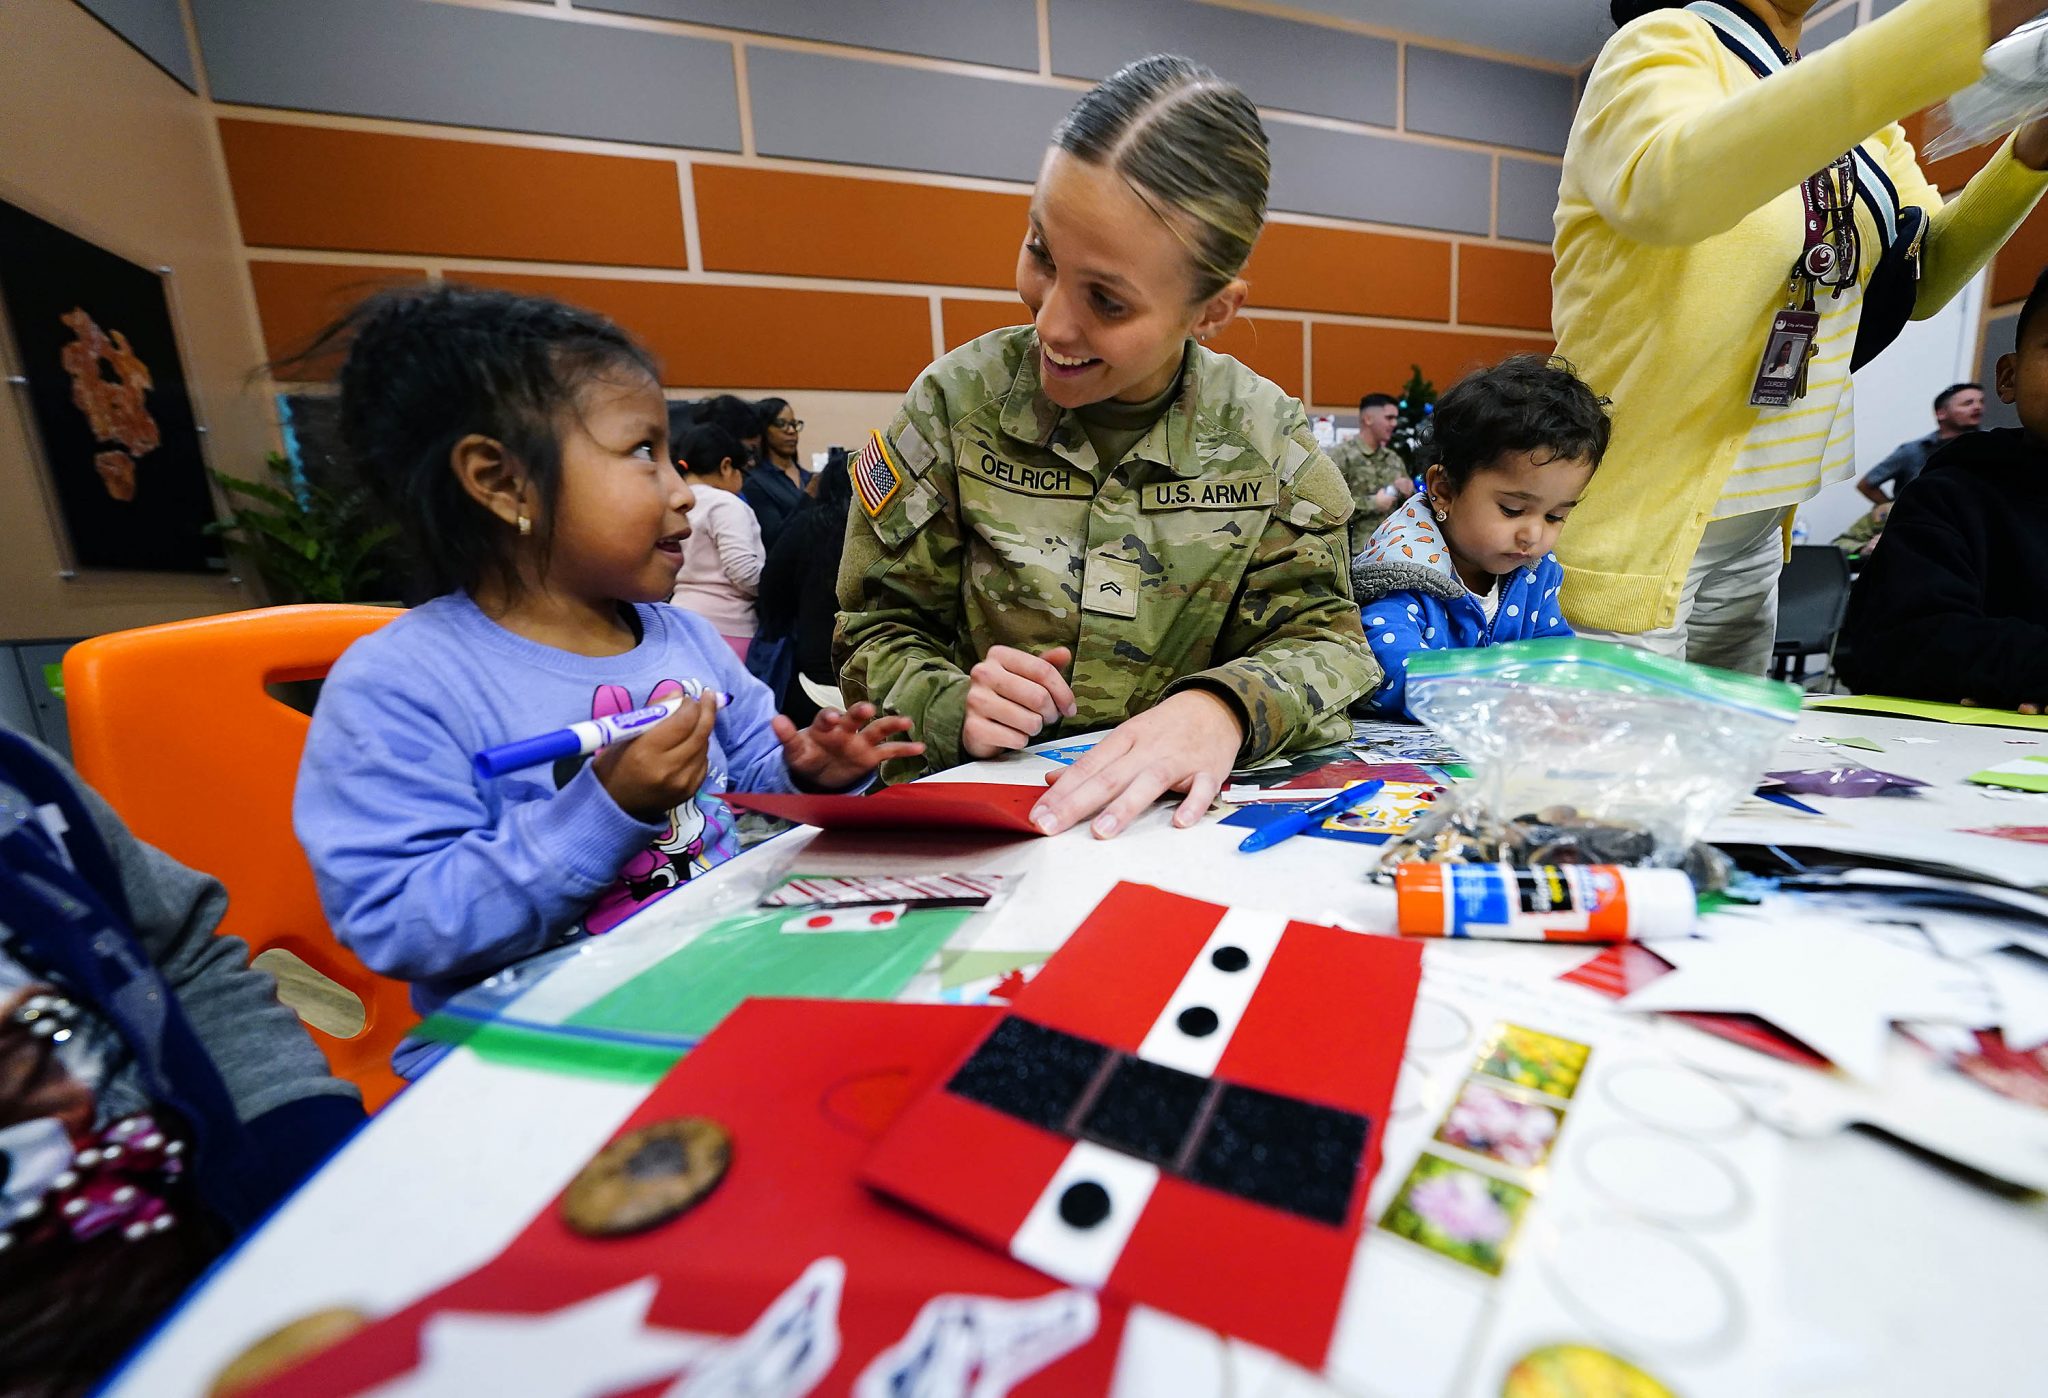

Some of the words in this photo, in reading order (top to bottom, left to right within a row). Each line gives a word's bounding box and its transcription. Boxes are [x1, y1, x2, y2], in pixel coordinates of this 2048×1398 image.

[1804, 180, 1814, 212] hoenix
[980, 453, 1071, 491] OELRICH
[1156, 484, 1196, 505] U.S.
[1201, 481, 1262, 504] ARMY
